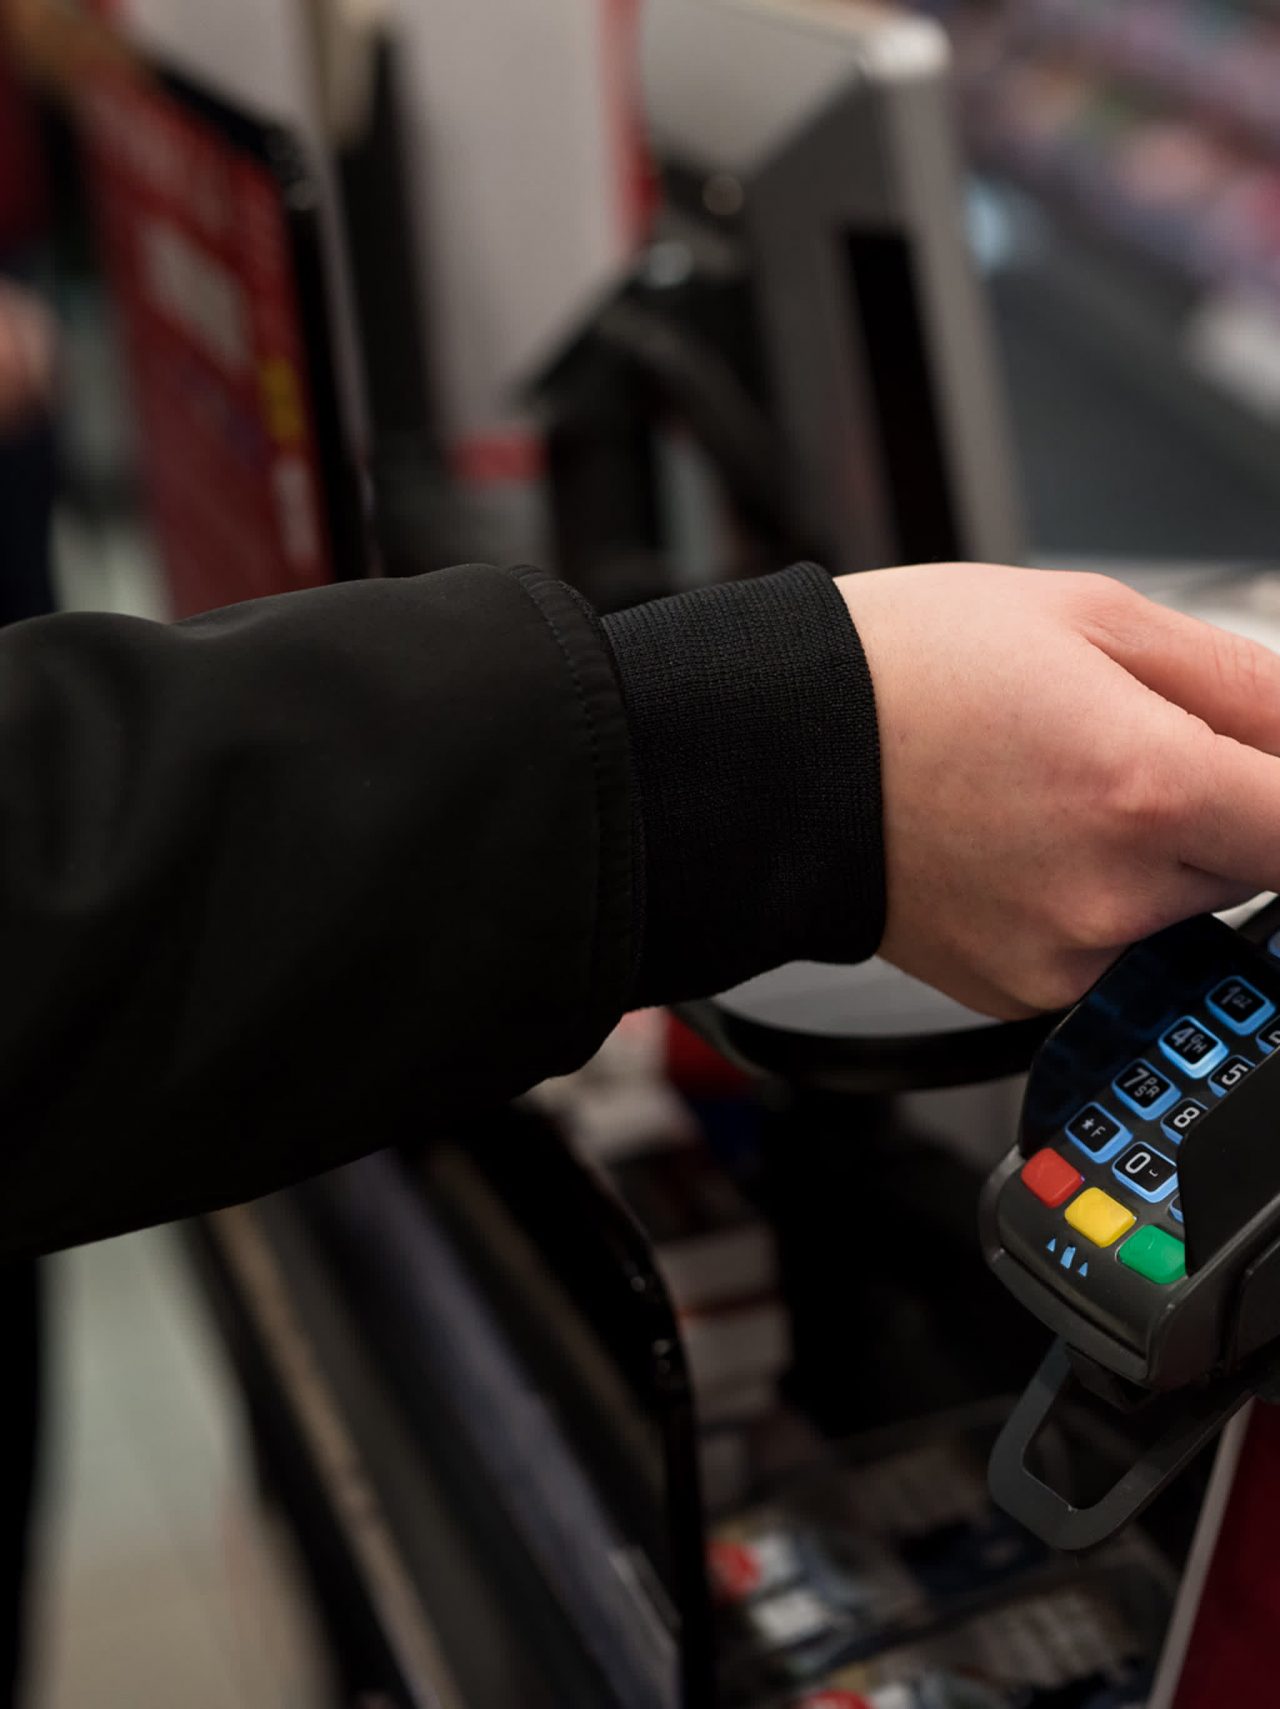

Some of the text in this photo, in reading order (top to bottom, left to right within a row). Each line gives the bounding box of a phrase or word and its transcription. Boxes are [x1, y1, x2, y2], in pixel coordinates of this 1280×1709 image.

[1221, 986, 1242, 1005] 1
[1171, 1027, 1196, 1047] 4
[1122, 1067, 1151, 1088] 7
[1221, 1063, 1249, 1086] 5
[1173, 1106, 1200, 1128] 8
[1125, 1151, 1151, 1174] 0
